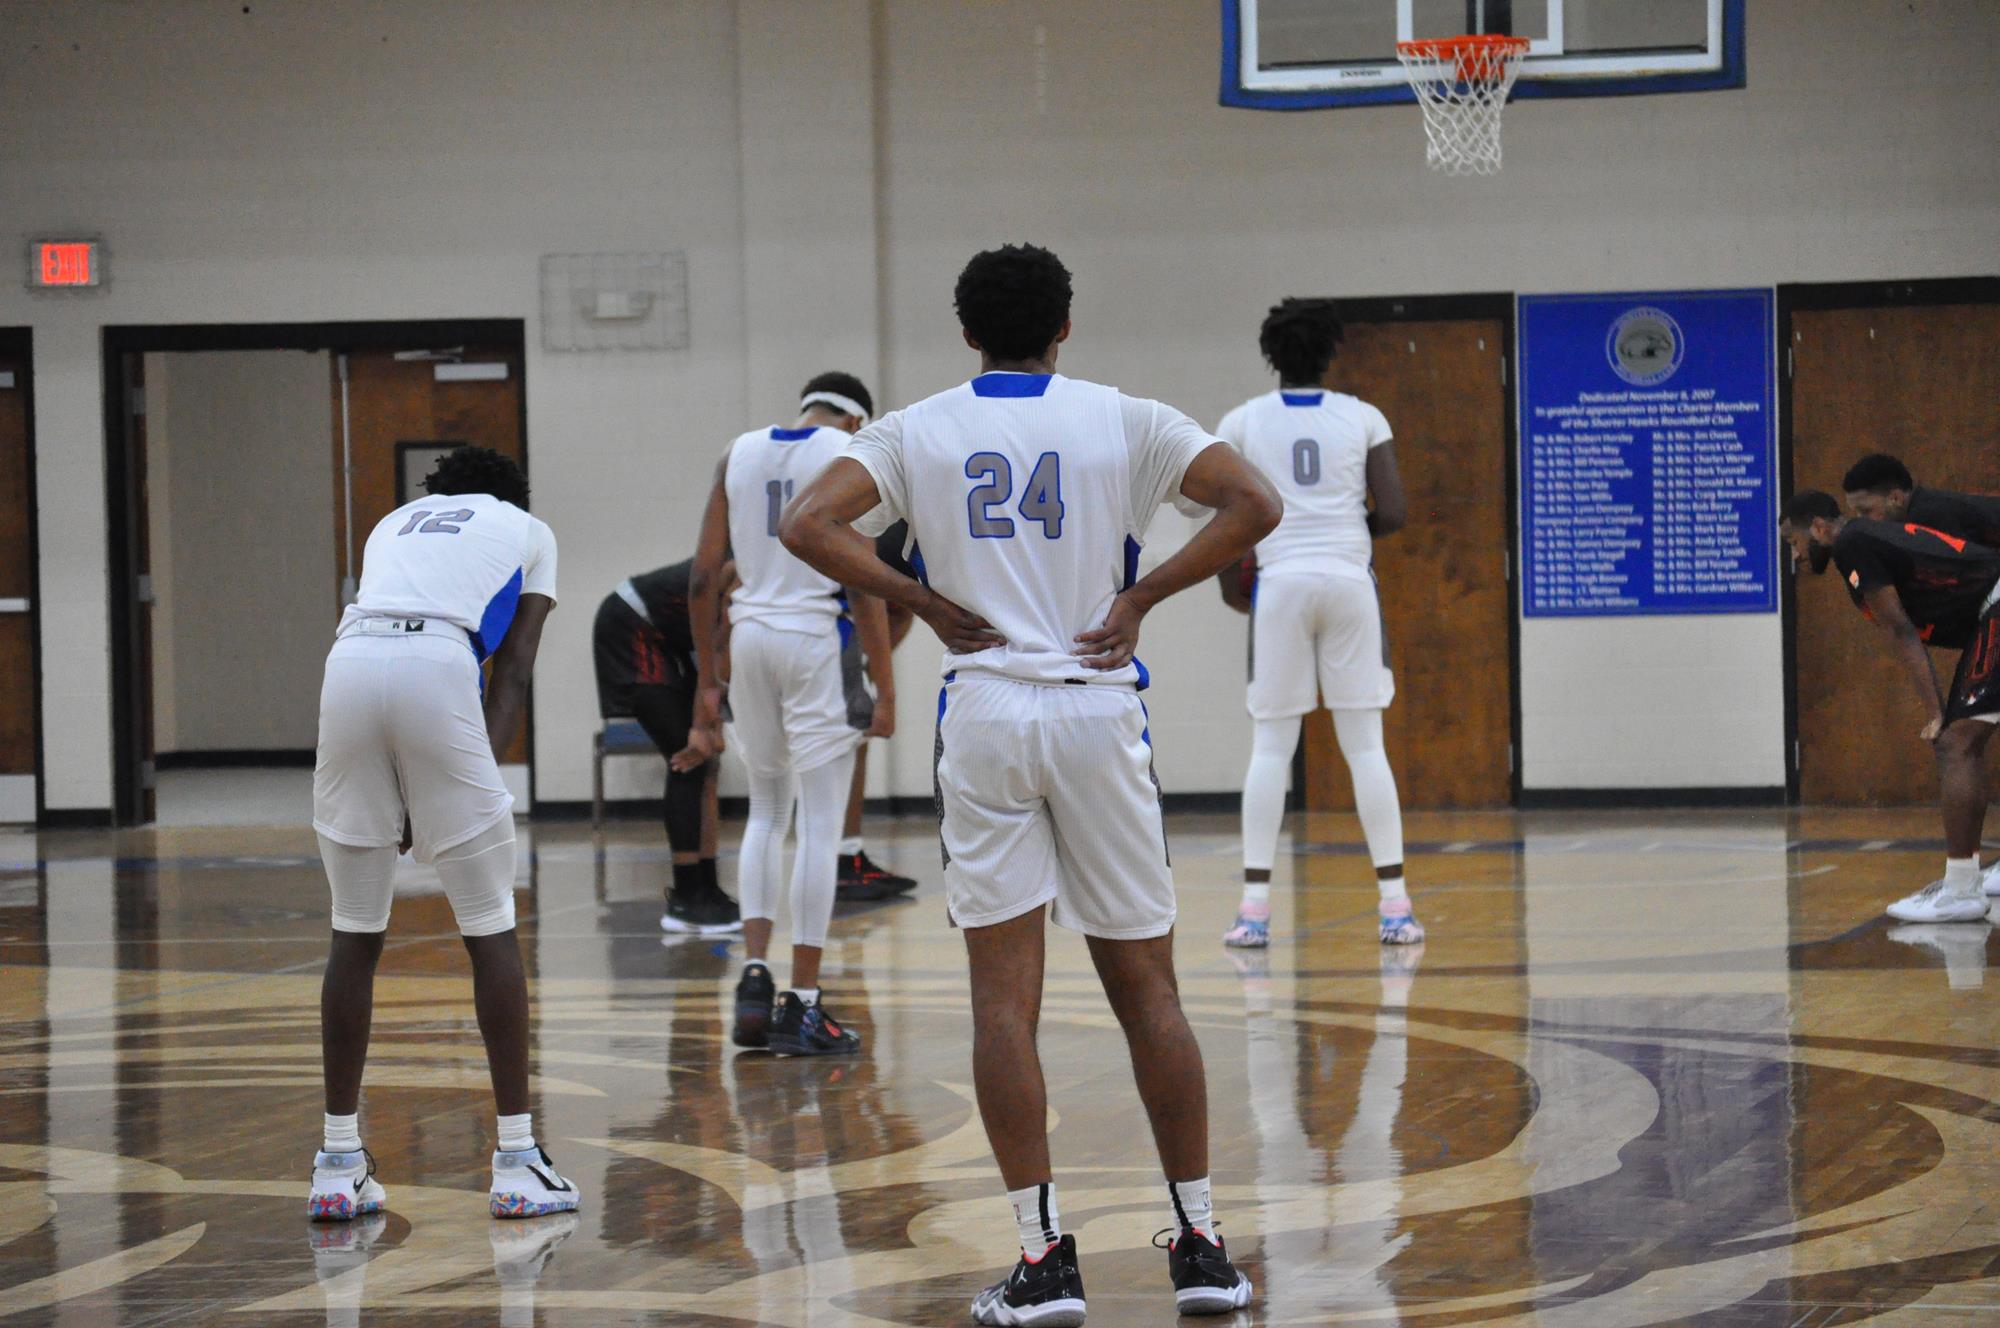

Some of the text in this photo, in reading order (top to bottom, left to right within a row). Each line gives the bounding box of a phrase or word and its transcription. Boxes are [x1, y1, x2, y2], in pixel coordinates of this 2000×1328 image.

[43, 243, 89, 284] EXIT
[1579, 392, 1628, 401] Dedicated
[1628, 391, 1678, 400] November
[1691, 390, 1714, 399] 2007
[1535, 403, 1758, 417] In grateful appreciation to the Charter Members
[1561, 420, 1572, 428] of
[1572, 419, 1588, 428] the
[1591, 418, 1625, 427] Shorter
[1627, 418, 1658, 426] Hawks
[1711, 416, 1733, 425] Club
[1693, 443, 1721, 452] Patrick
[1293, 439, 1320, 486] 0
[1693, 478, 1724, 487] Donald
[965, 452, 1064, 539] 24
[766, 479, 793, 537] 1
[398, 508, 475, 536] 12
[1604, 515, 1643, 526] Company
[1722, 548, 1746, 556] Smith
[1728, 583, 1763, 592] Williams
[1604, 597, 1638, 606] Williams
